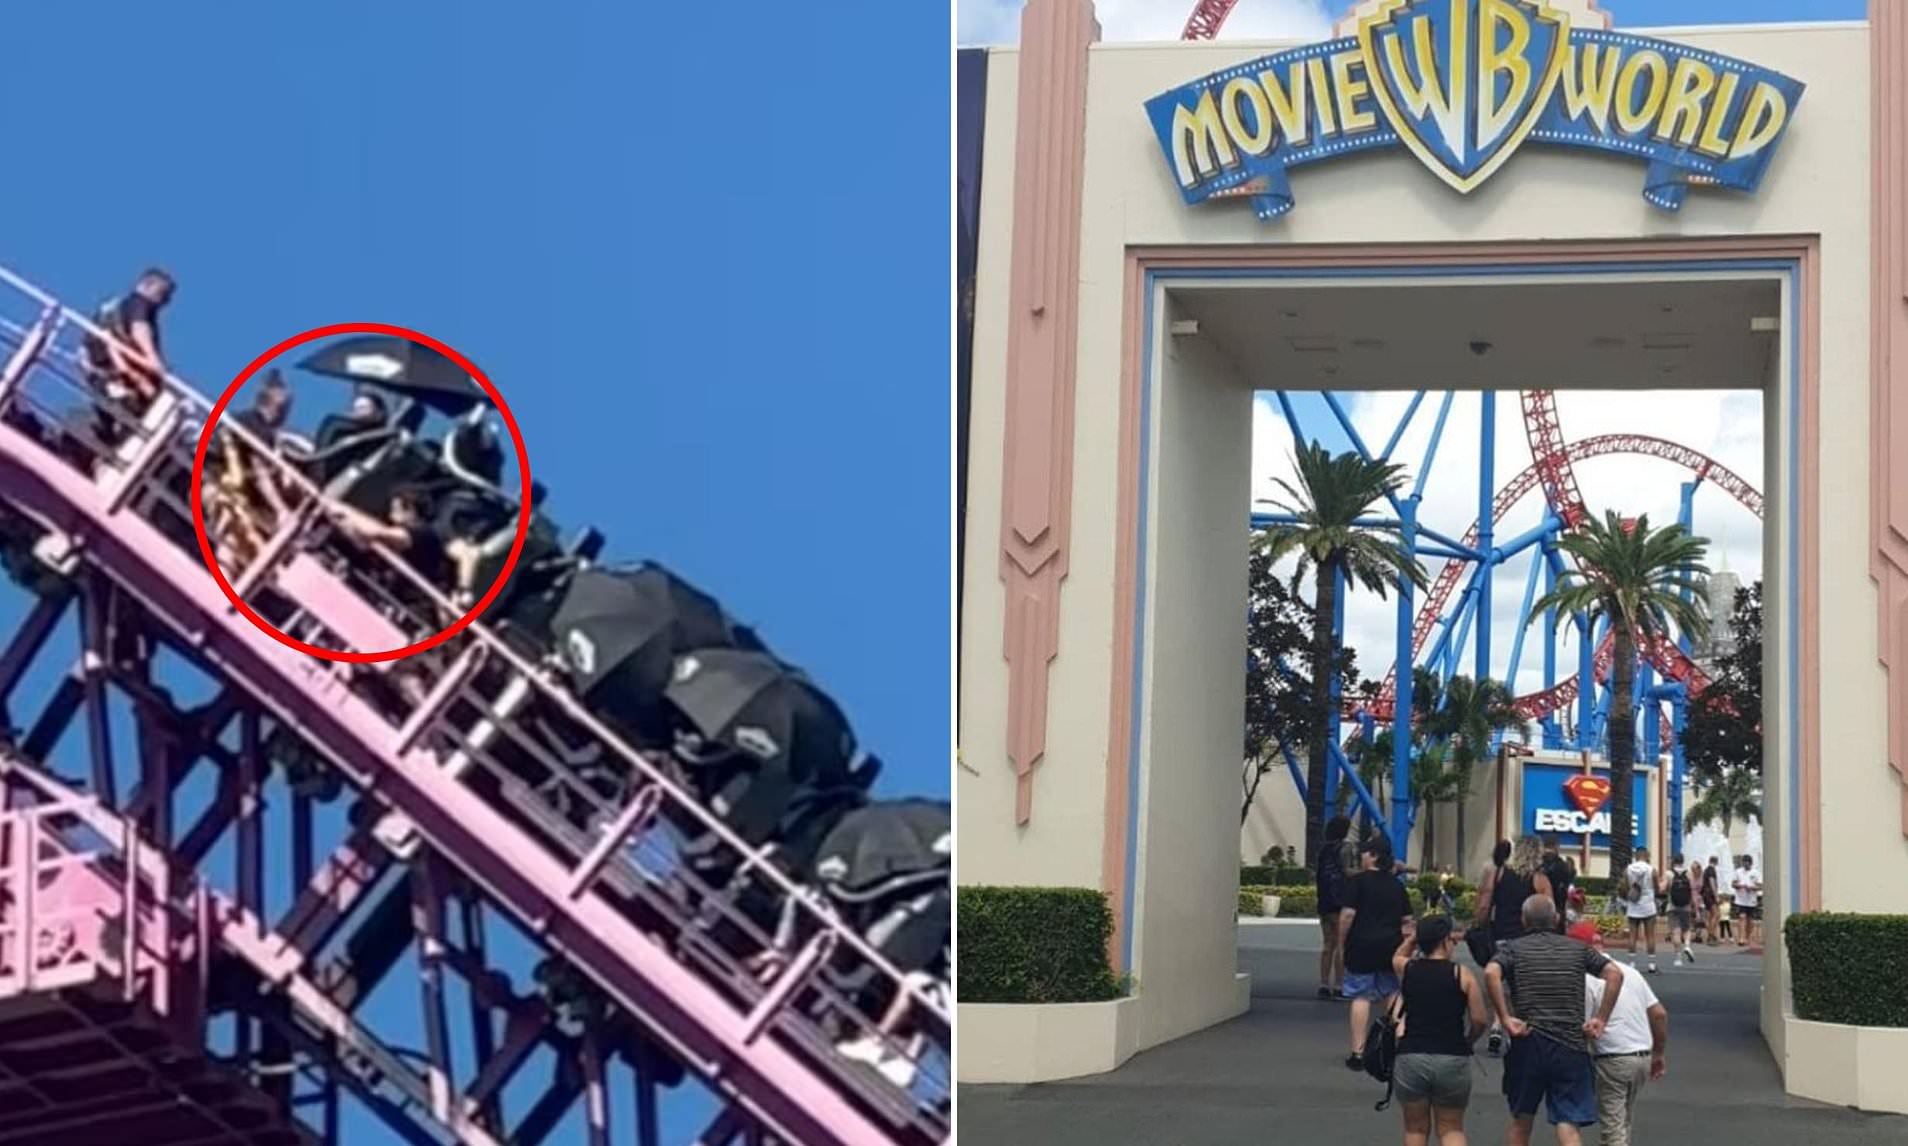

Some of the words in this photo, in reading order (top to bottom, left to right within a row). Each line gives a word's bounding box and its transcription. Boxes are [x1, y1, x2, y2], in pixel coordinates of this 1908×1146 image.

[1171, 49, 1377, 188] MOVIE
[1562, 42, 1788, 160] WORLD
[1384, 0, 1531, 165] WB
